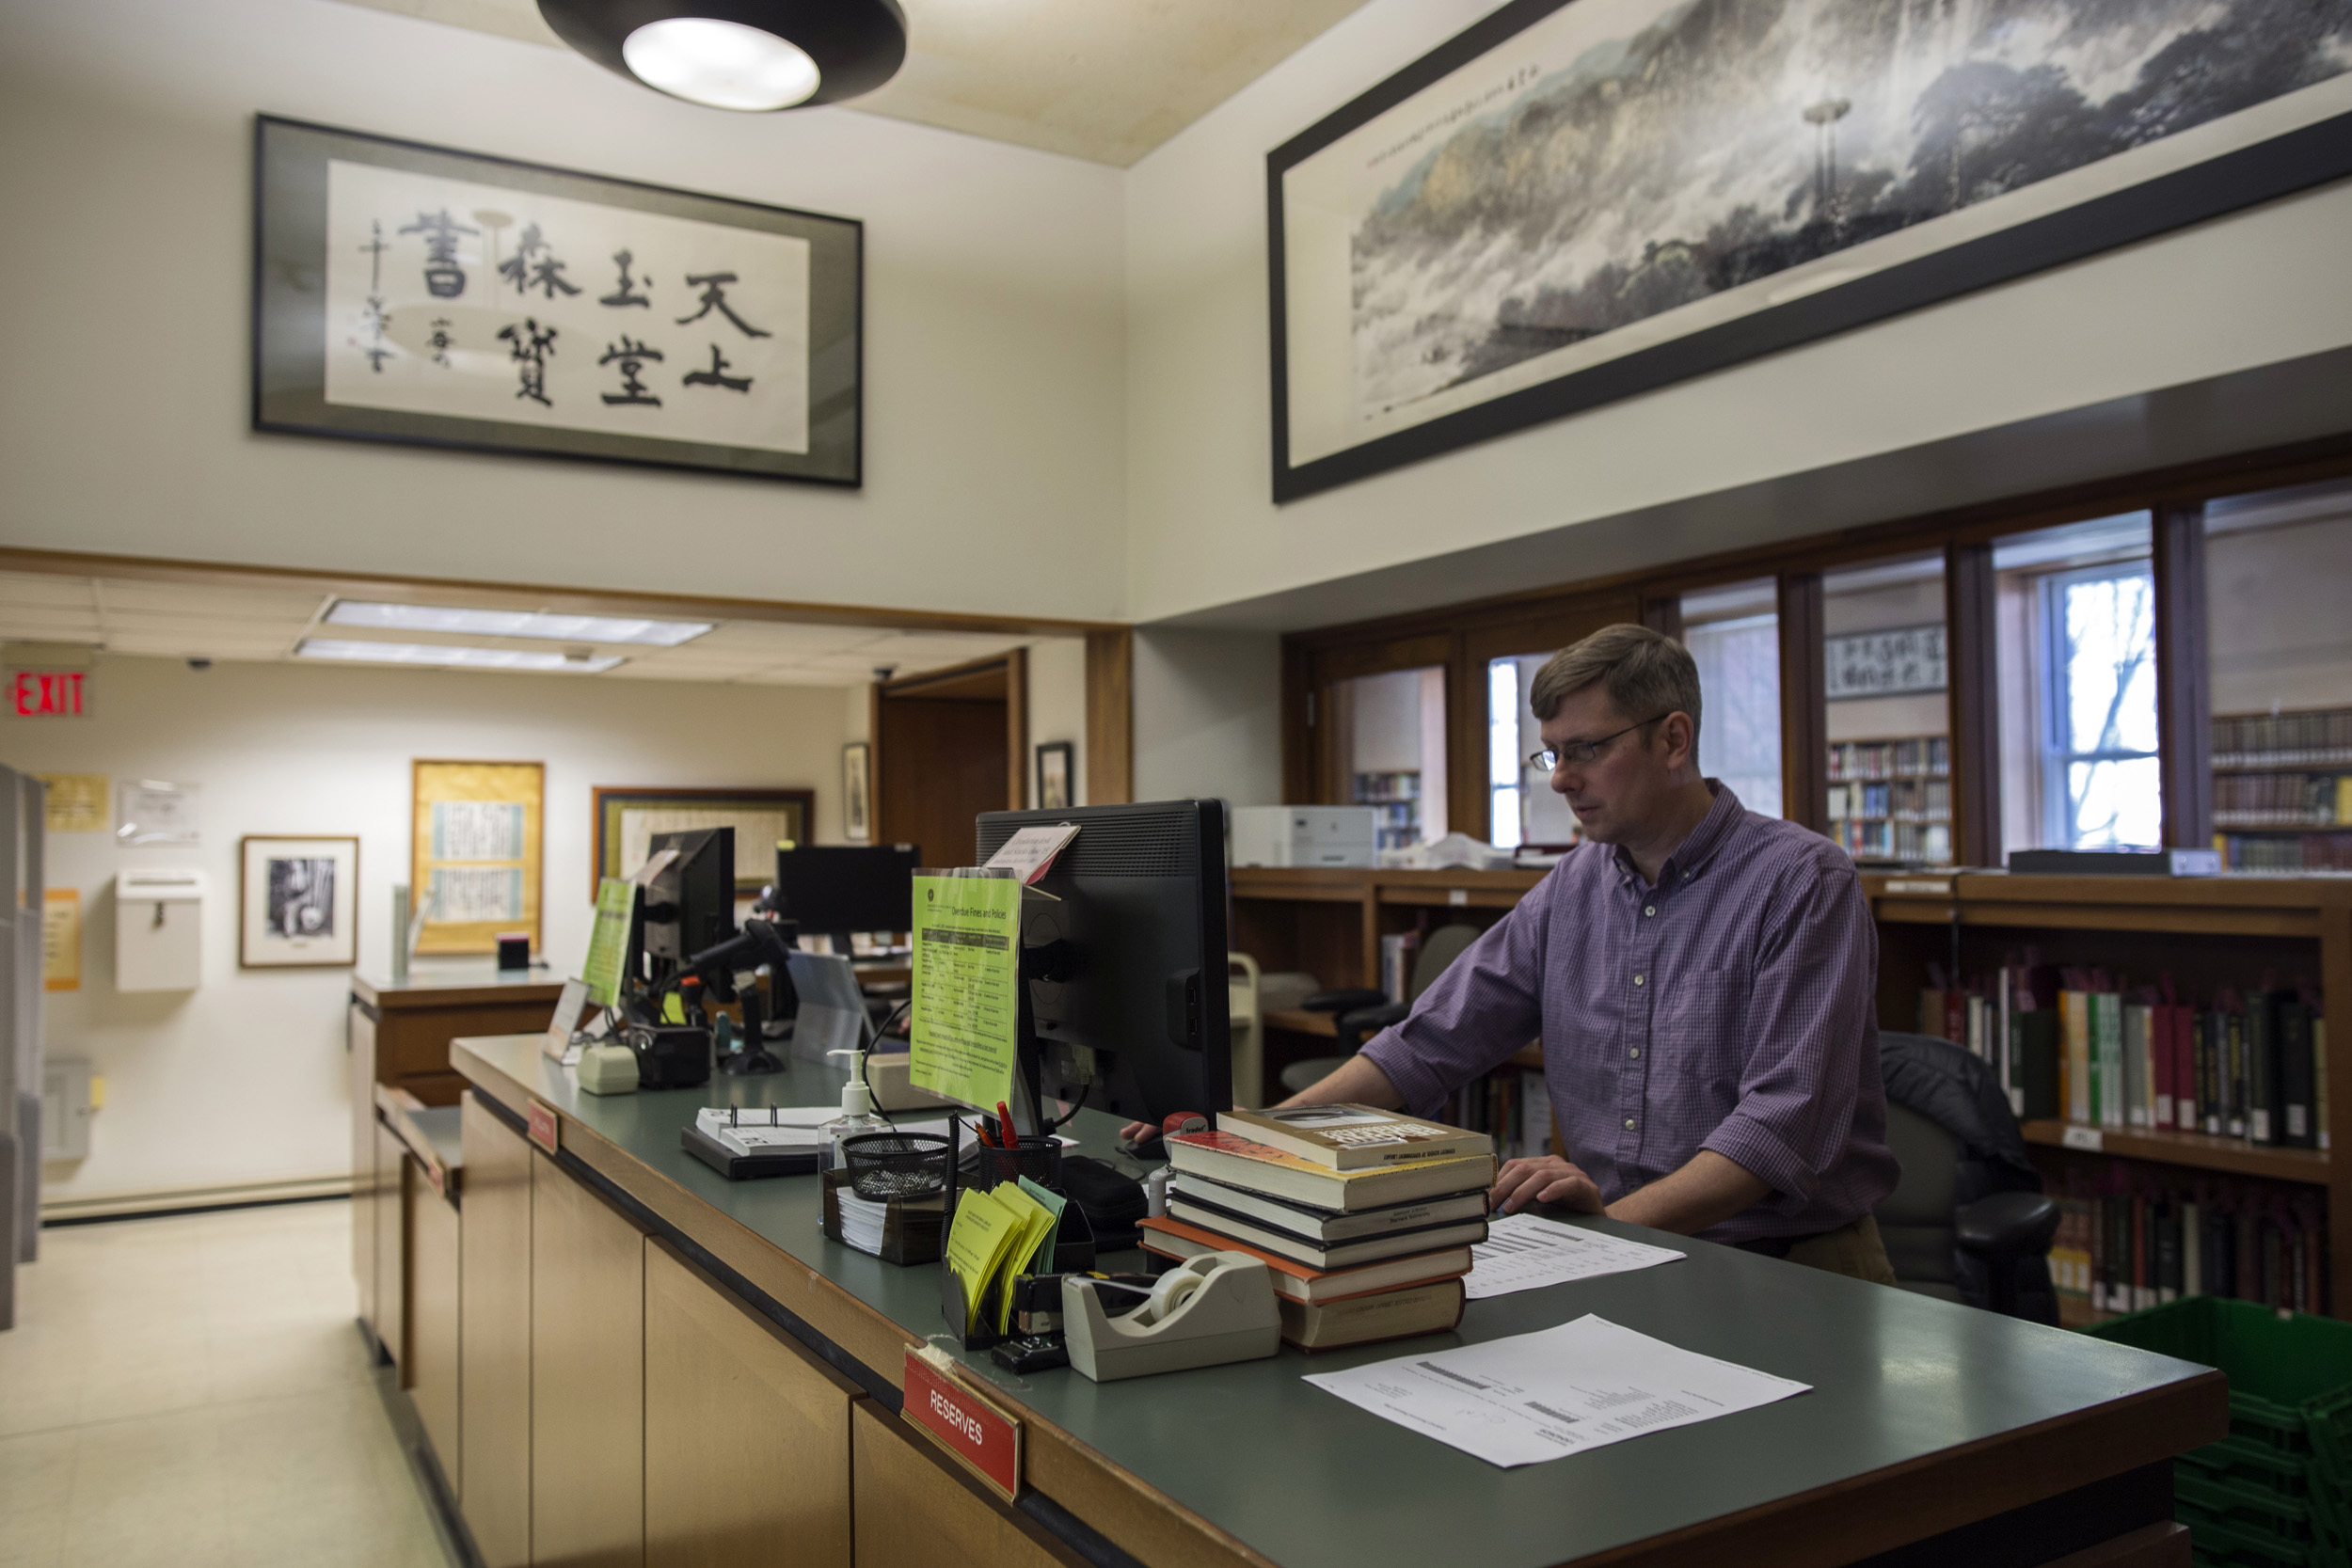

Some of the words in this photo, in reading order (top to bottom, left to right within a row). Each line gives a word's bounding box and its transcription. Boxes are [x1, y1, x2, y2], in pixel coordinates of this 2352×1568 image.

[15, 672, 86, 716] EXIT
[952, 906, 969, 917] Overdue
[970, 907, 982, 918] Fines
[992, 909, 1007, 920] Policies
[930, 1388, 982, 1446] RESERVES
